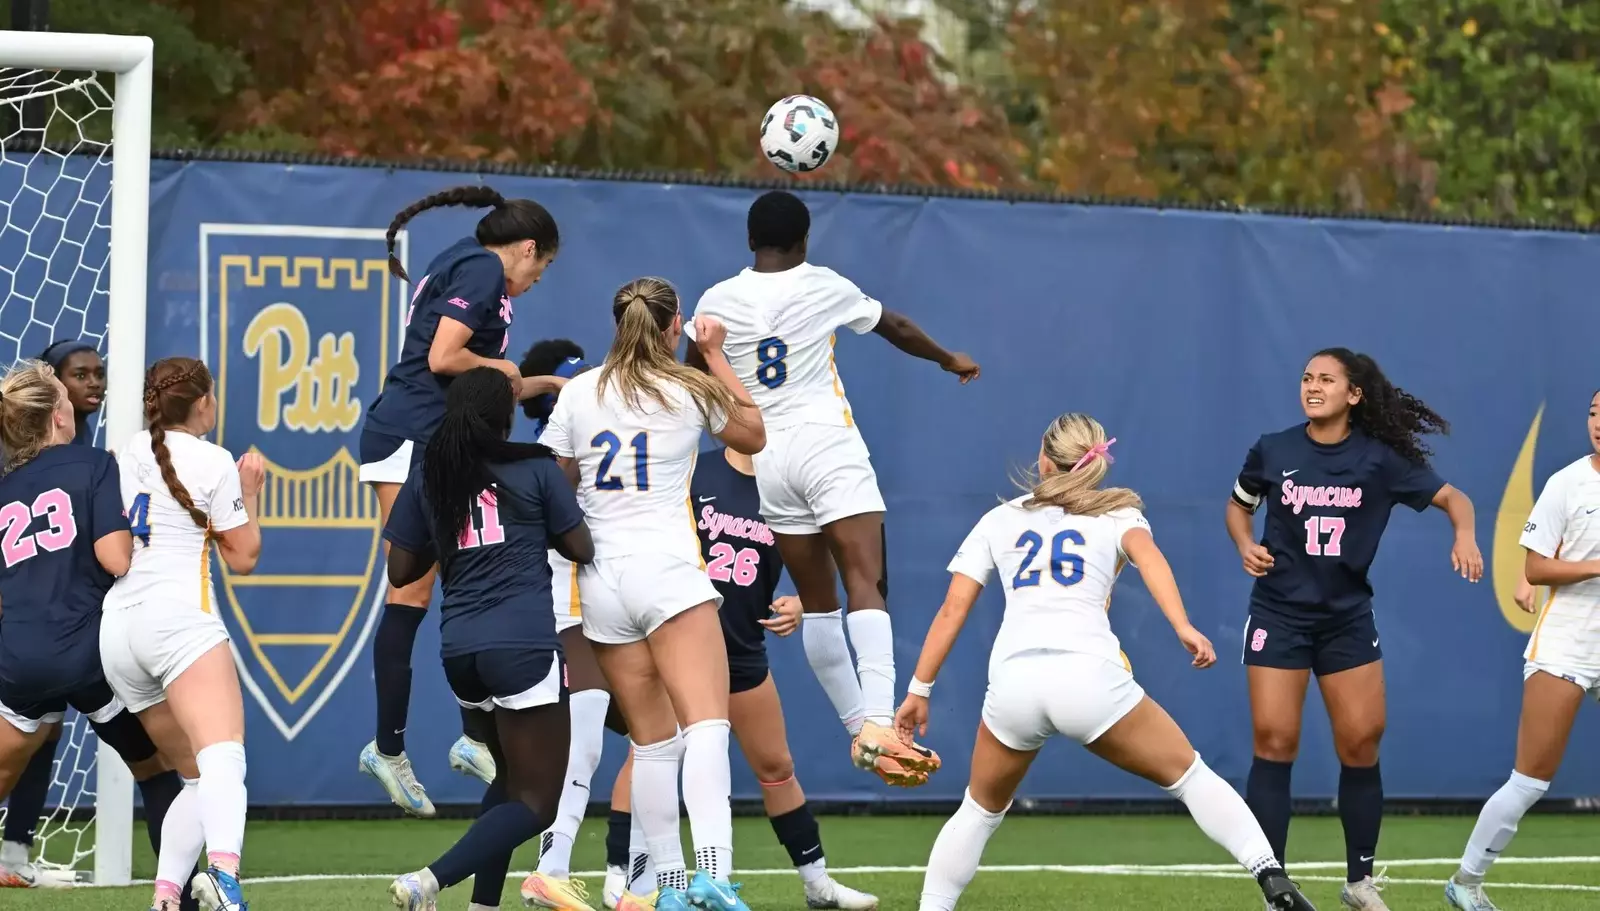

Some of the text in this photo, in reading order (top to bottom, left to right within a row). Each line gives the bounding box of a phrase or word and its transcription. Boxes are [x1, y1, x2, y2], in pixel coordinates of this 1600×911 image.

[243, 302, 361, 433] Pitt
[756, 336, 788, 390] 8
[590, 429, 649, 492] 21
[128, 492, 151, 548] 4
[1281, 479, 1362, 515] Syracuse
[0, 487, 78, 568] 23
[1304, 516, 1346, 556] 17
[707, 541, 760, 587] 26
[1012, 529, 1086, 590] 26
[1251, 628, 1267, 652] S
